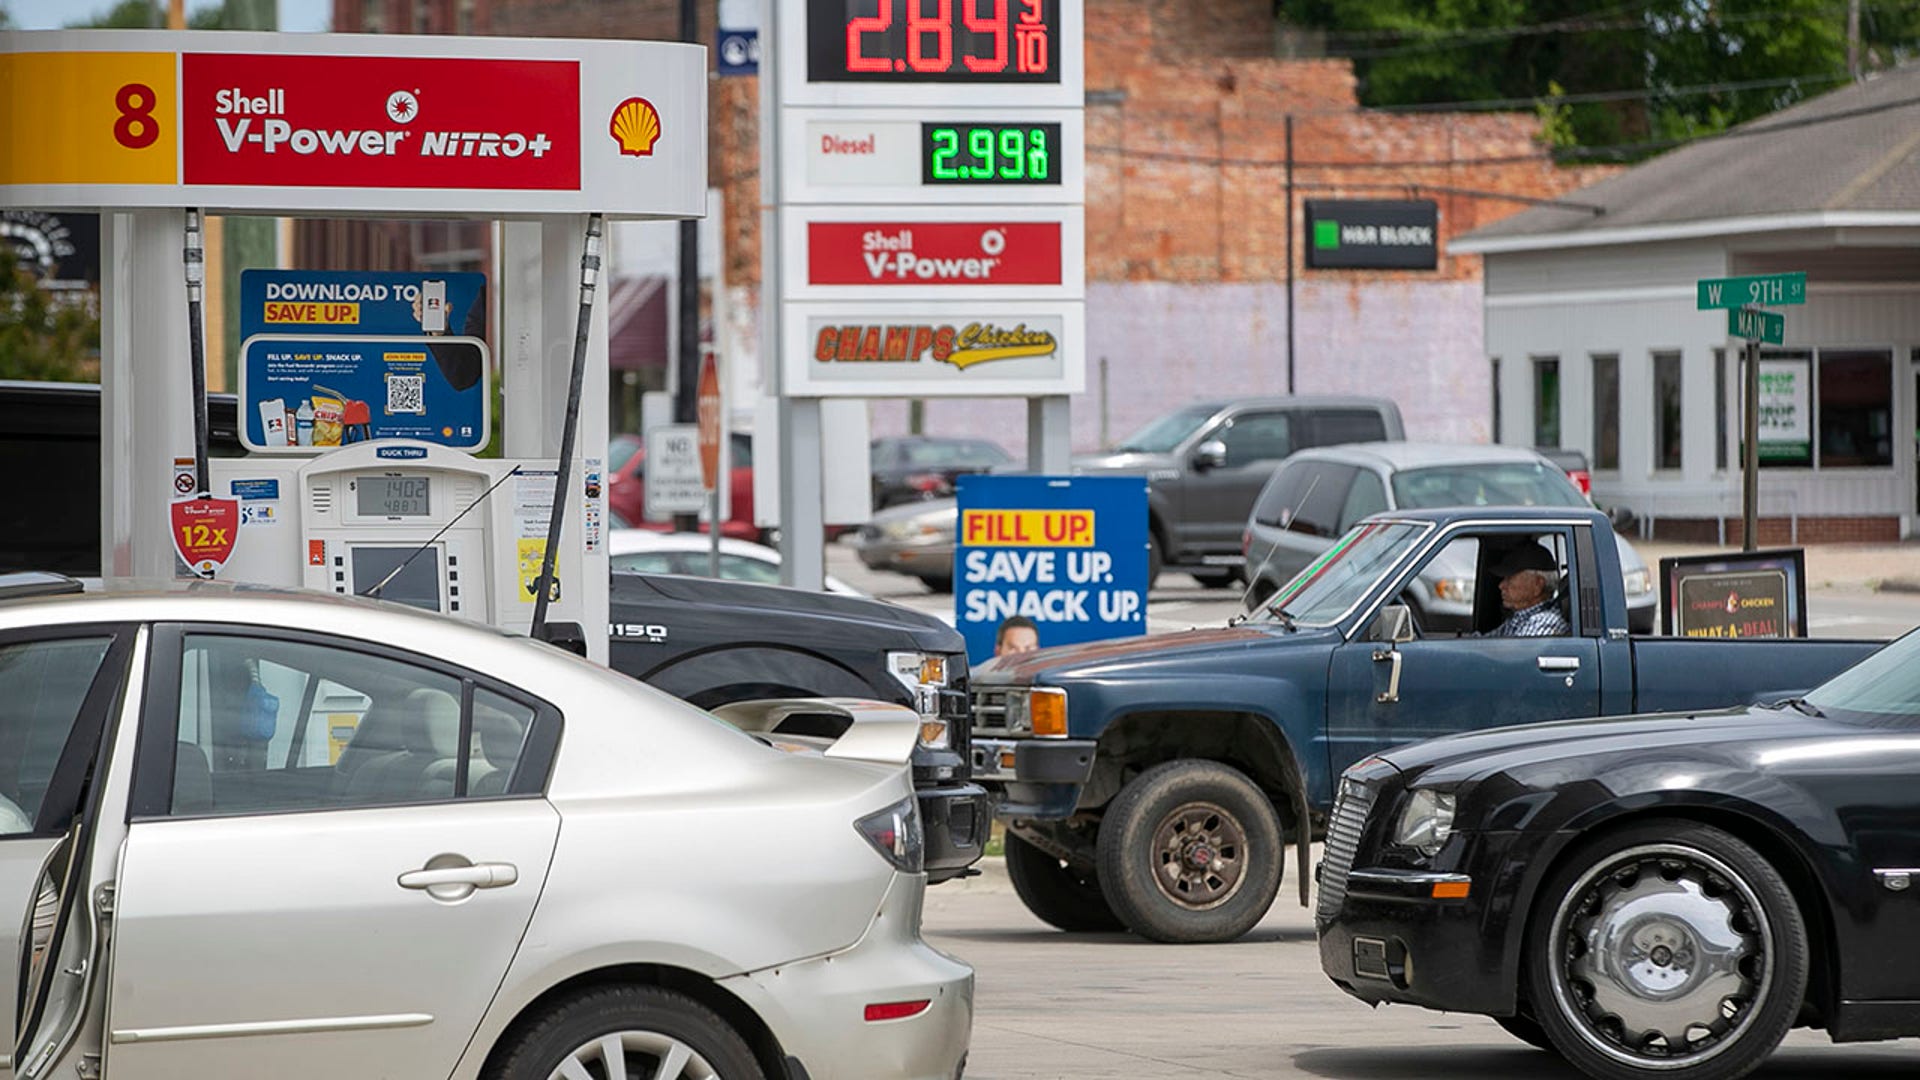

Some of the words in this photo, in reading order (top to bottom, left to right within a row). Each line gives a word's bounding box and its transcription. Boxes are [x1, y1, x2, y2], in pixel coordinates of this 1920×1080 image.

[846, 0, 1008, 72] 2.89
[215, 87, 285, 115] Shell
[113, 83, 160, 149] 8
[215, 118, 405, 156] V-Power
[822, 134, 876, 154] Diesel
[931, 129, 1025, 179] 2.99
[862, 230, 913, 251] Shell
[1341, 225, 1378, 245] H&R
[1380, 225, 1433, 245] BLOCK
[862, 252, 996, 279] V-Power
[266, 282, 388, 301] DOWNLOAD
[392, 284, 420, 302] TO
[1707, 282, 1723, 306] W
[1748, 279, 1783, 303] 9TH
[266, 304, 317, 321] SAVE
[323, 304, 358, 322] UP.
[1738, 310, 1766, 339] MAIN
[814, 324, 957, 363] CHAMPS
[956, 321, 1053, 351] Chicken
[381, 449, 403, 457] DUCK
[404, 449, 424, 457] THRU
[182, 524, 229, 547] 12x
[967, 513, 1030, 542] FILL
[1043, 513, 1091, 542] UP.
[964, 551, 1056, 583] SAVE
[1066, 551, 1114, 584] UP.
[964, 589, 1090, 622] SNACK
[1098, 589, 1141, 622] UP.
[1741, 597, 1775, 608] CHICKEN
